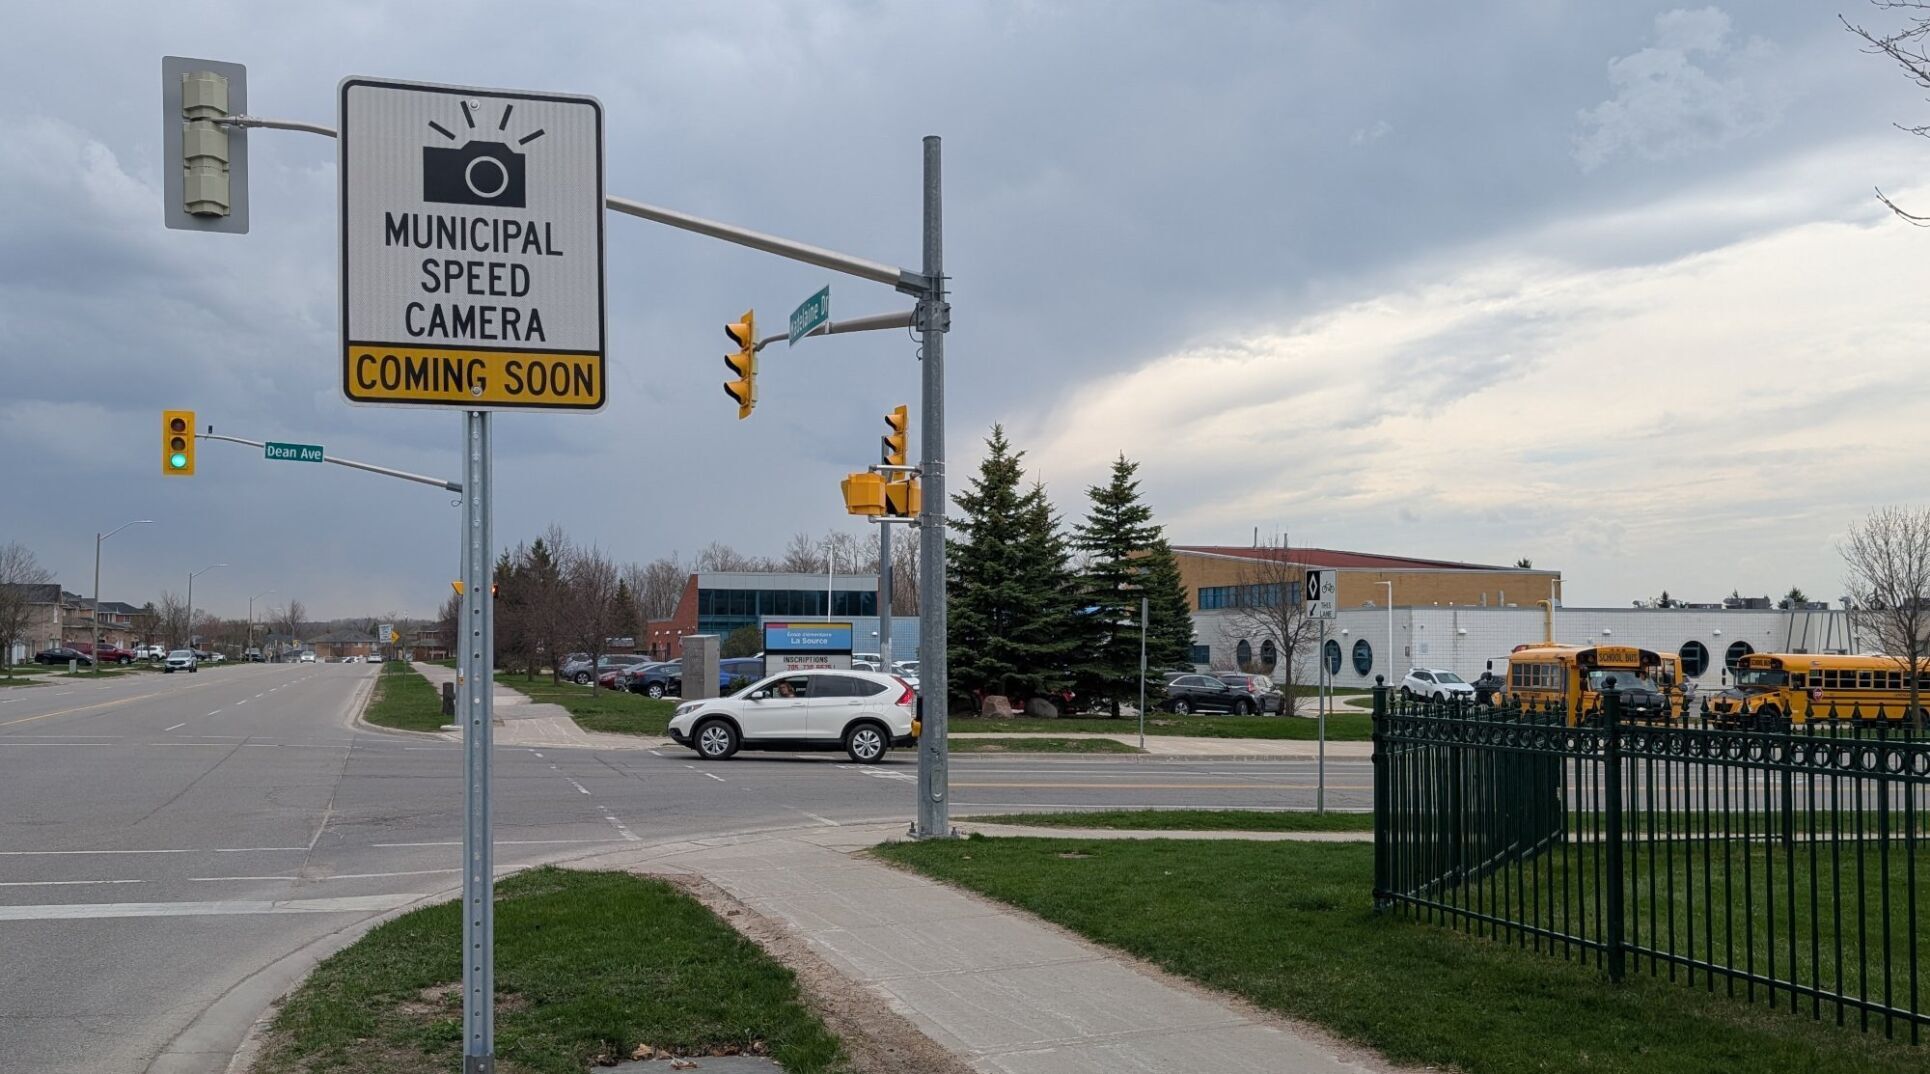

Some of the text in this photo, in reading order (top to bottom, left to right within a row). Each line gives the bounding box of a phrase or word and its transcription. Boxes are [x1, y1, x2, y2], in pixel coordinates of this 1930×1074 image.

[385, 212, 563, 256] MUNICIPAL
[421, 258, 530, 297] SPEED
[405, 302, 546, 342] CAMERA
[356, 354, 594, 397] COMING SOON
[267, 445, 321, 459] Dean Ave
[1320, 610, 1332, 618] LANE
[791, 637, 828, 645] La Source
[1599, 653, 1624, 662] SCHOOL
